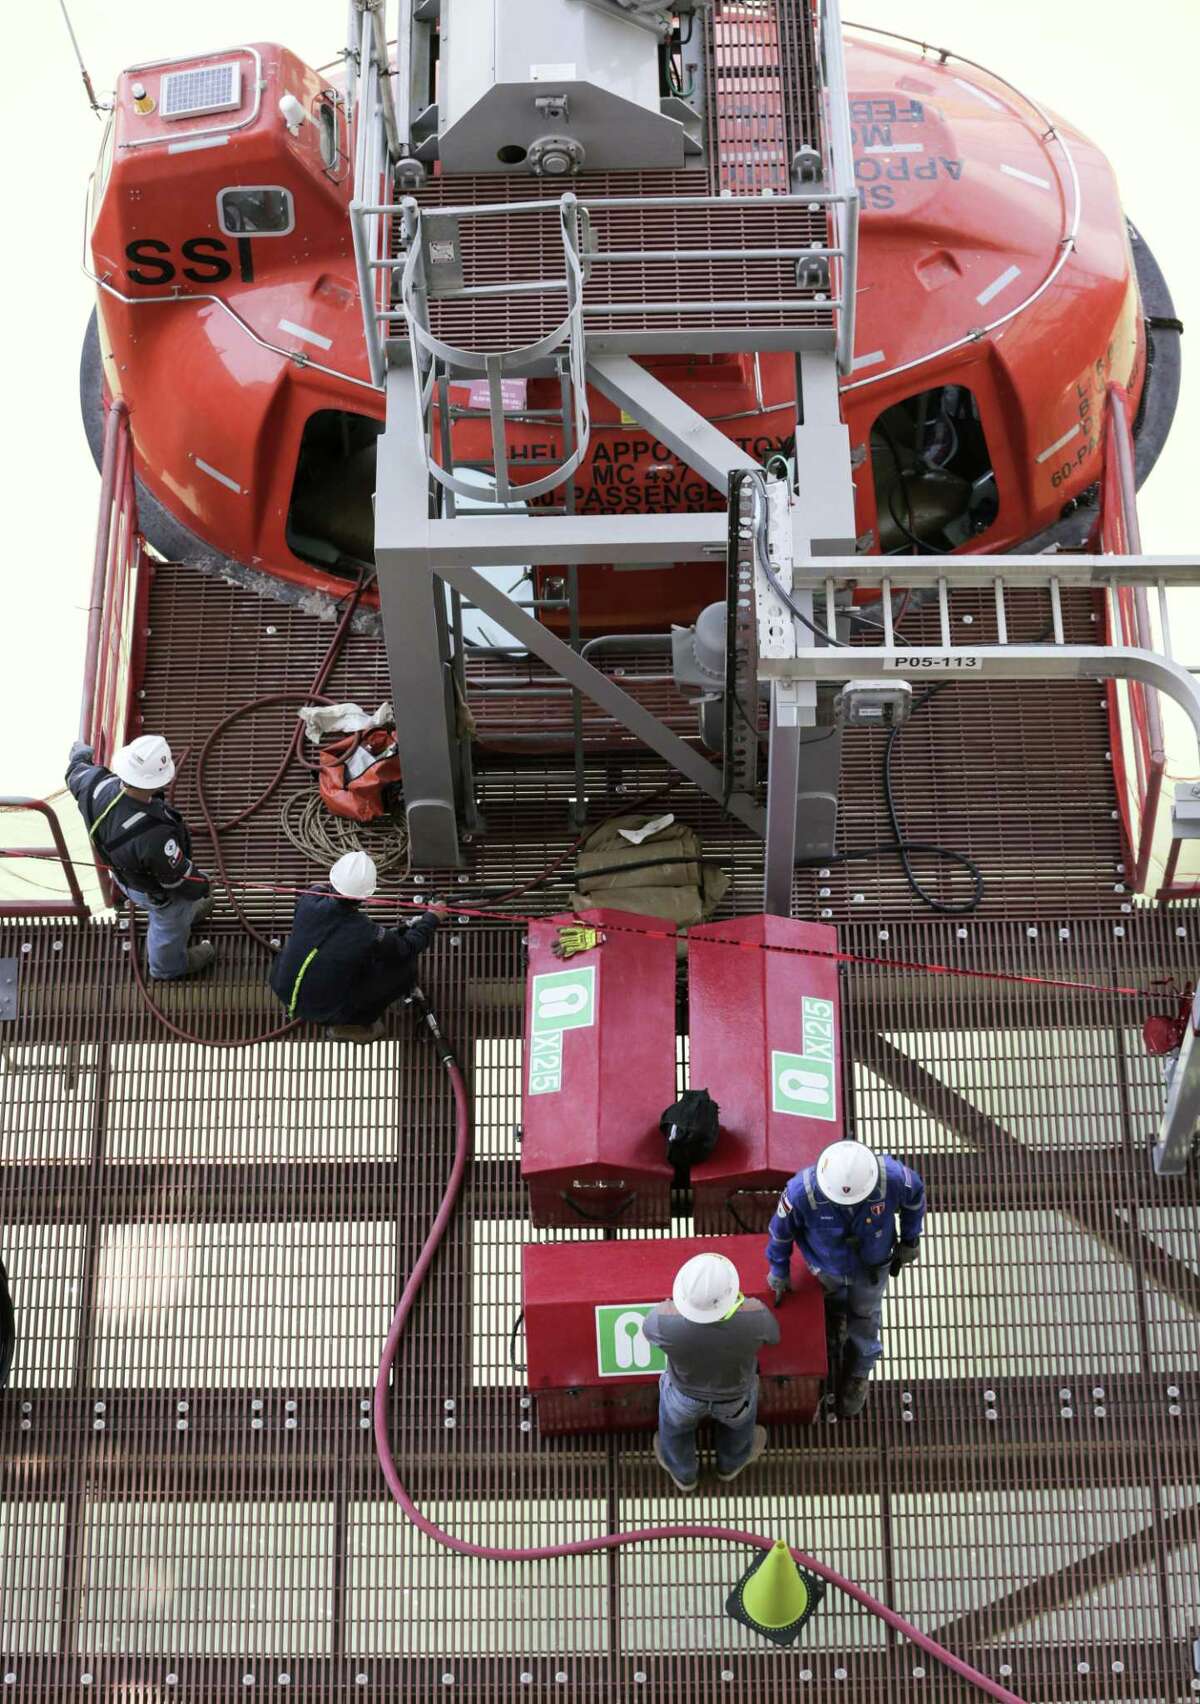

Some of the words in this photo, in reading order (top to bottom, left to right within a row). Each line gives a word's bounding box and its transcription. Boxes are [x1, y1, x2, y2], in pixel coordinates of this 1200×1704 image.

[852, 124, 893, 146] M
[860, 185, 896, 209] S
[124, 237, 254, 286] SSI
[592, 464, 636, 485] MC
[894, 656, 977, 668] P05-113
[804, 1000, 833, 1059] X25
[531, 1032, 561, 1091] X25
